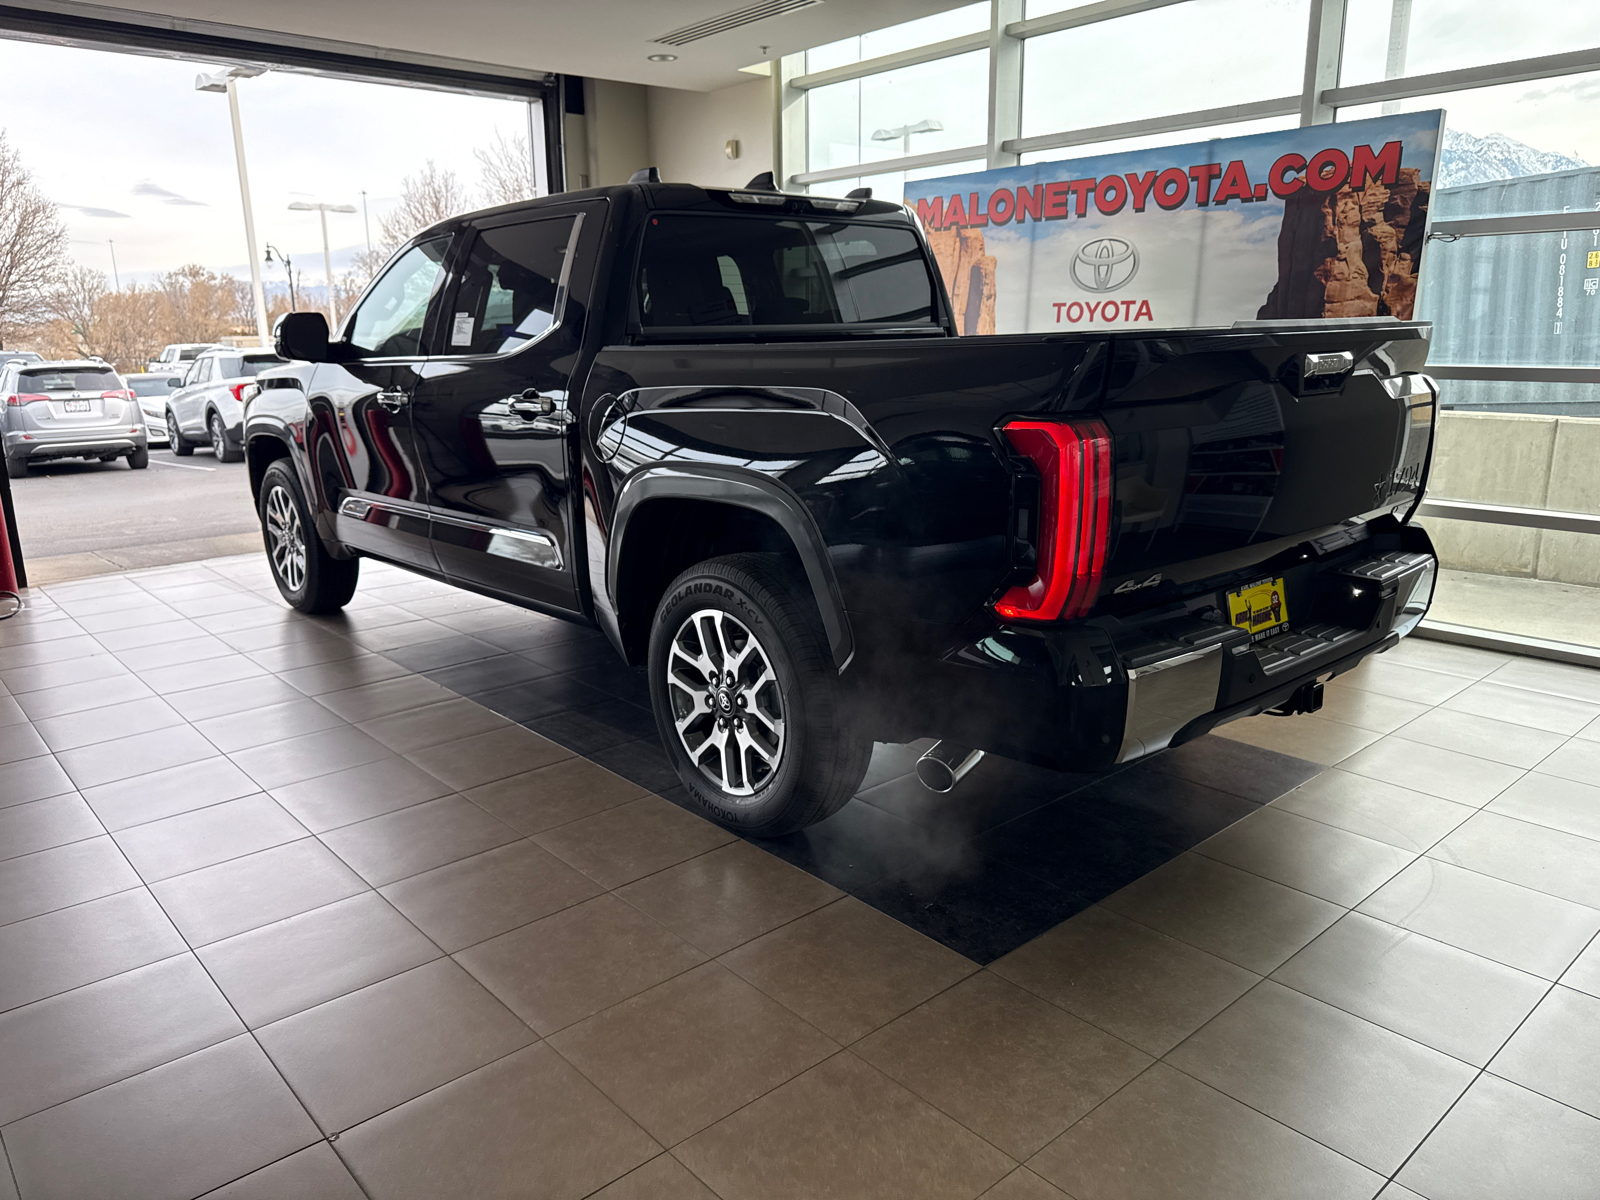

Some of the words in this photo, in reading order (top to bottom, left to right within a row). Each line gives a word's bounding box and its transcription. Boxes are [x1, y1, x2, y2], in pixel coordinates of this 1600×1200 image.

[917, 140, 1403, 231] MALONETOYOTA.COM
[1052, 299, 1154, 323] TOYOTA
[659, 582, 735, 625] GEOLANDAR
[1272, 594, 1278, 604] 32
[1270, 626, 1280, 636] EASY
[688, 781, 740, 823] YOKOHAMA
